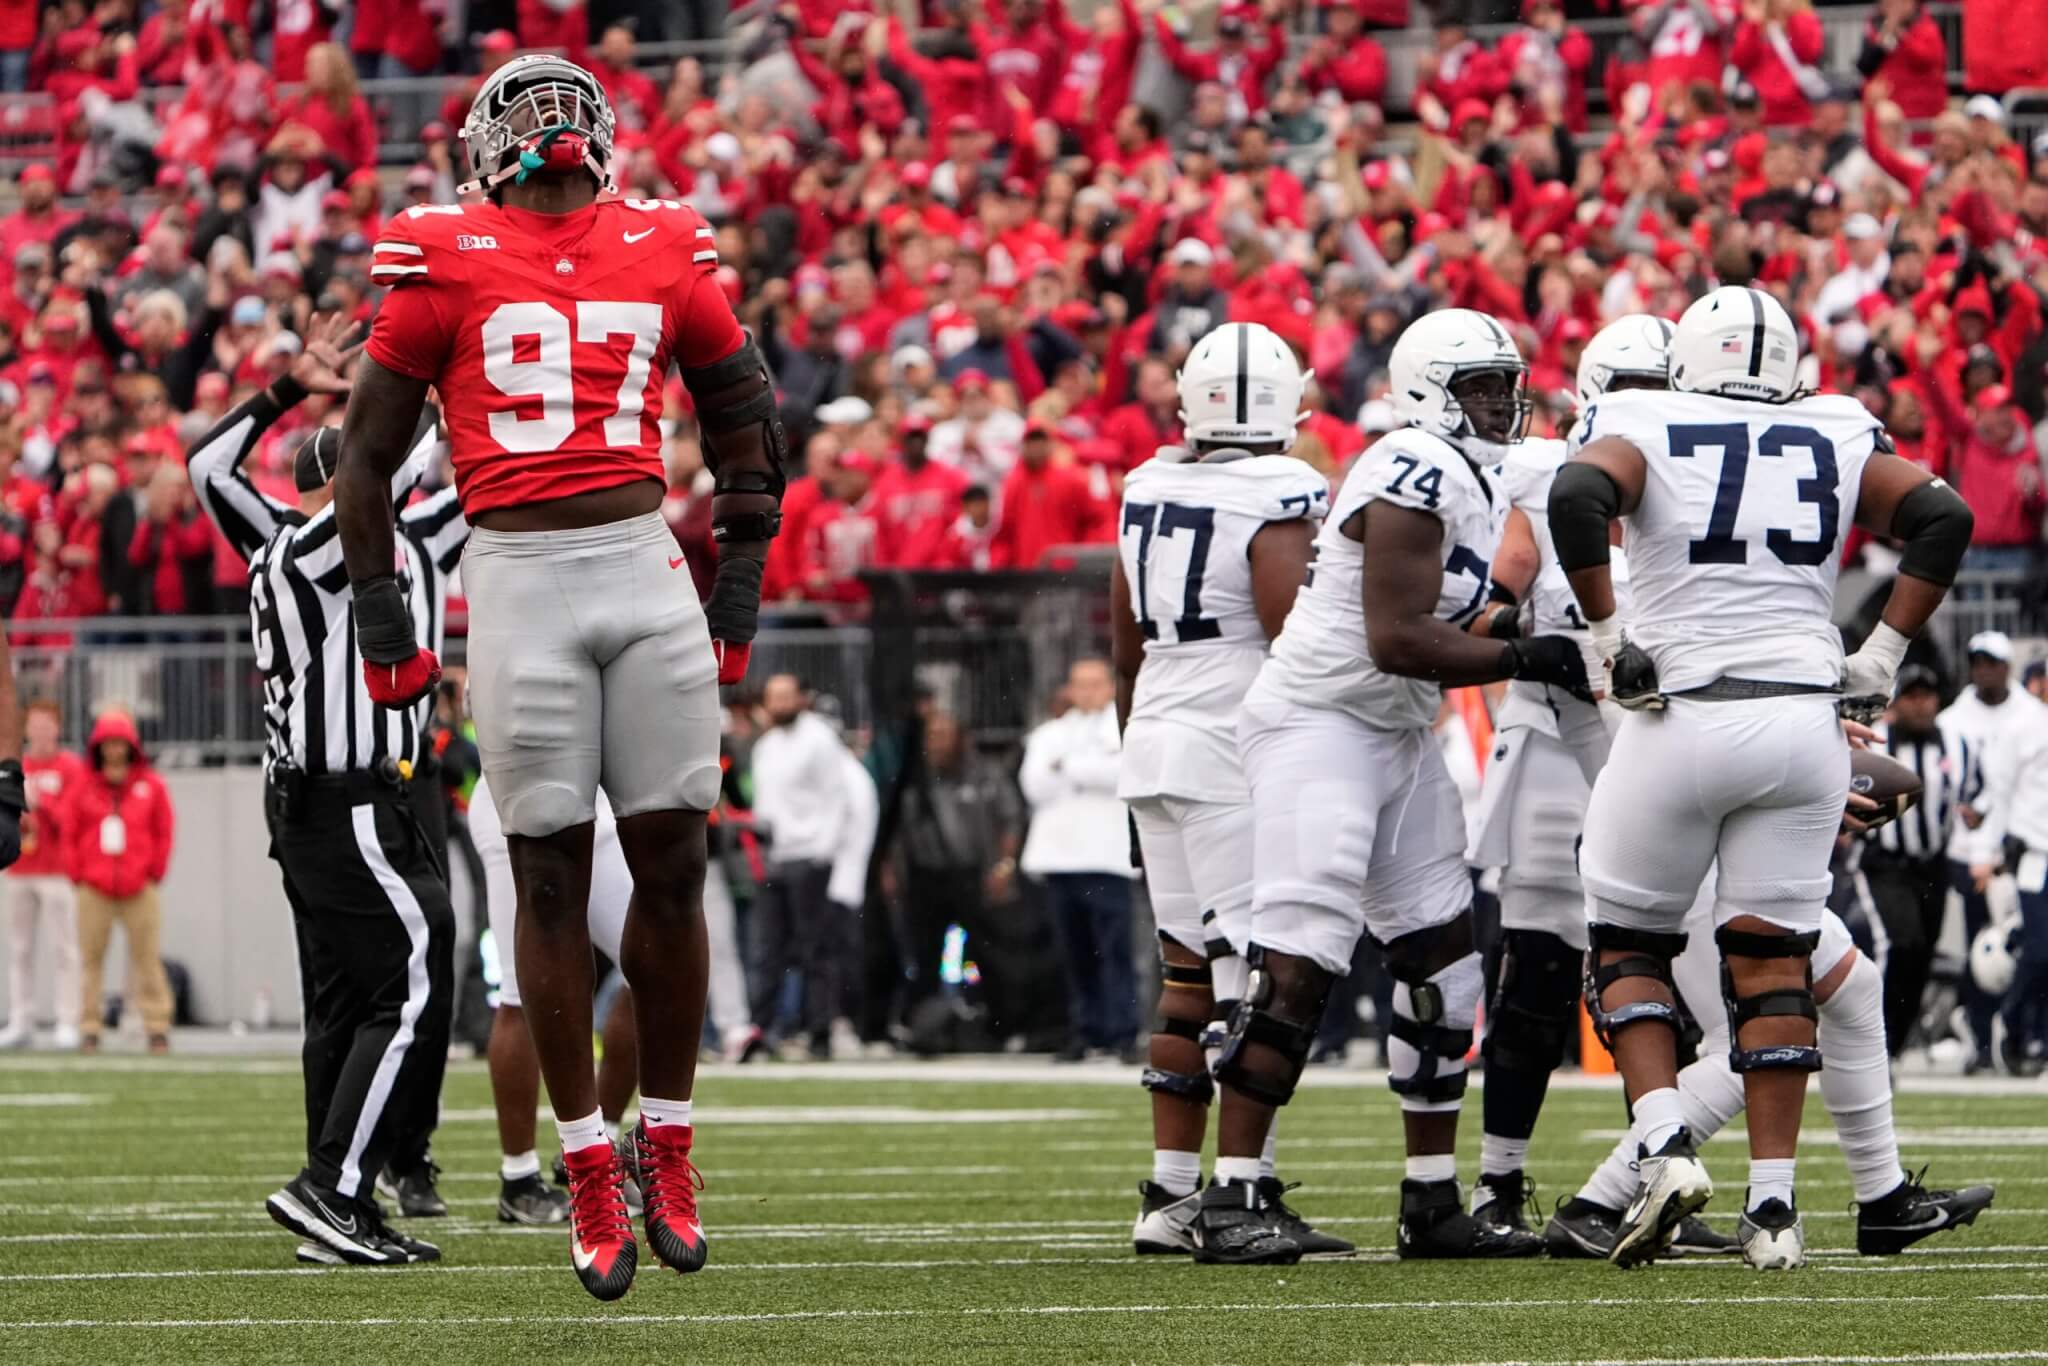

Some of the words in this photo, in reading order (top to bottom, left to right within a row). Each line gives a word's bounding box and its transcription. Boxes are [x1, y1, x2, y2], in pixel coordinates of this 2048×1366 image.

[482, 301, 663, 453] 97
[1385, 454, 1443, 508] 74
[1667, 422, 1839, 566] 73
[1123, 502, 1222, 642] 77
